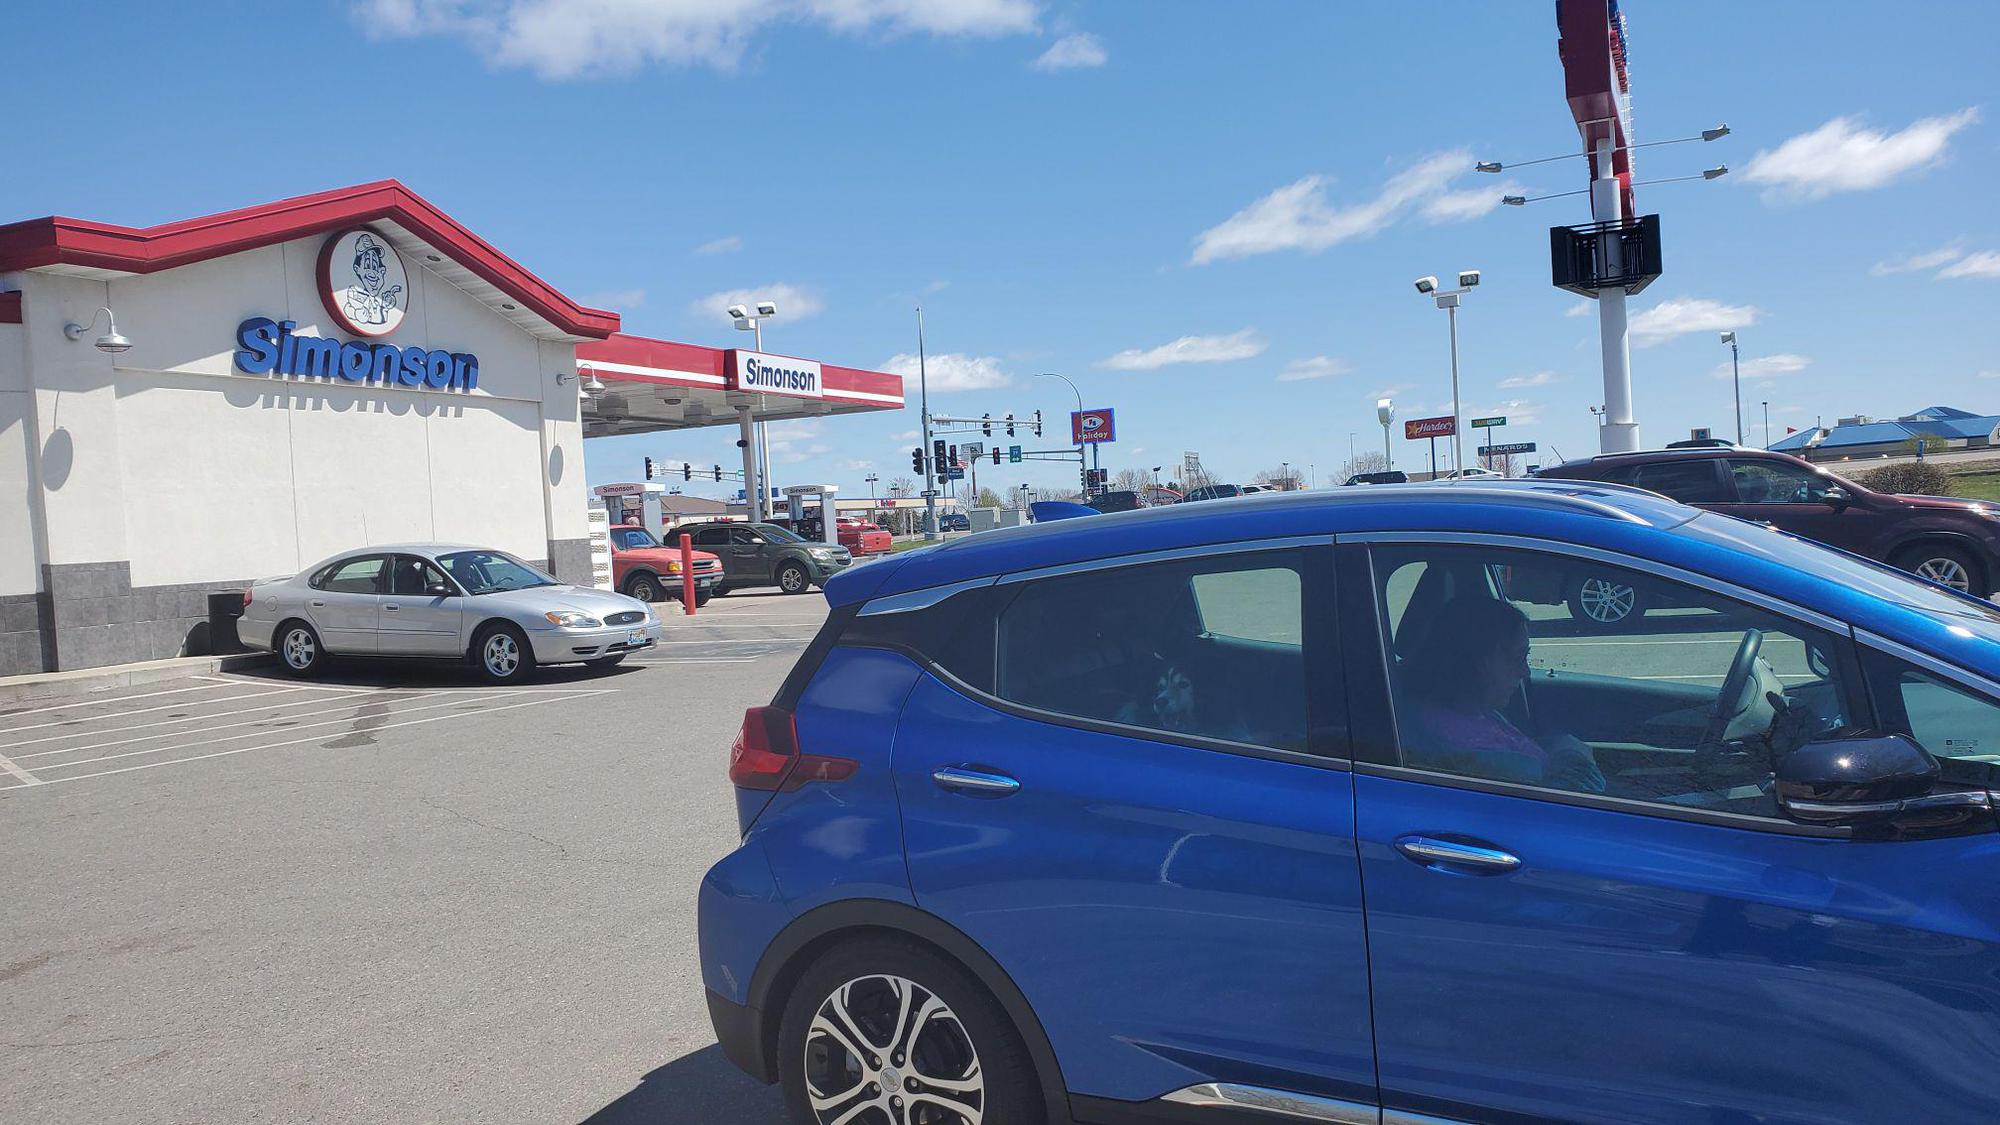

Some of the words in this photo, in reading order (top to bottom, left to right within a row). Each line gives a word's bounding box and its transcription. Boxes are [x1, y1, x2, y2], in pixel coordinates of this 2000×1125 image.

[234, 317, 478, 389] Simonson
[745, 358, 815, 391] Simonson
[602, 485, 635, 494] Simonson
